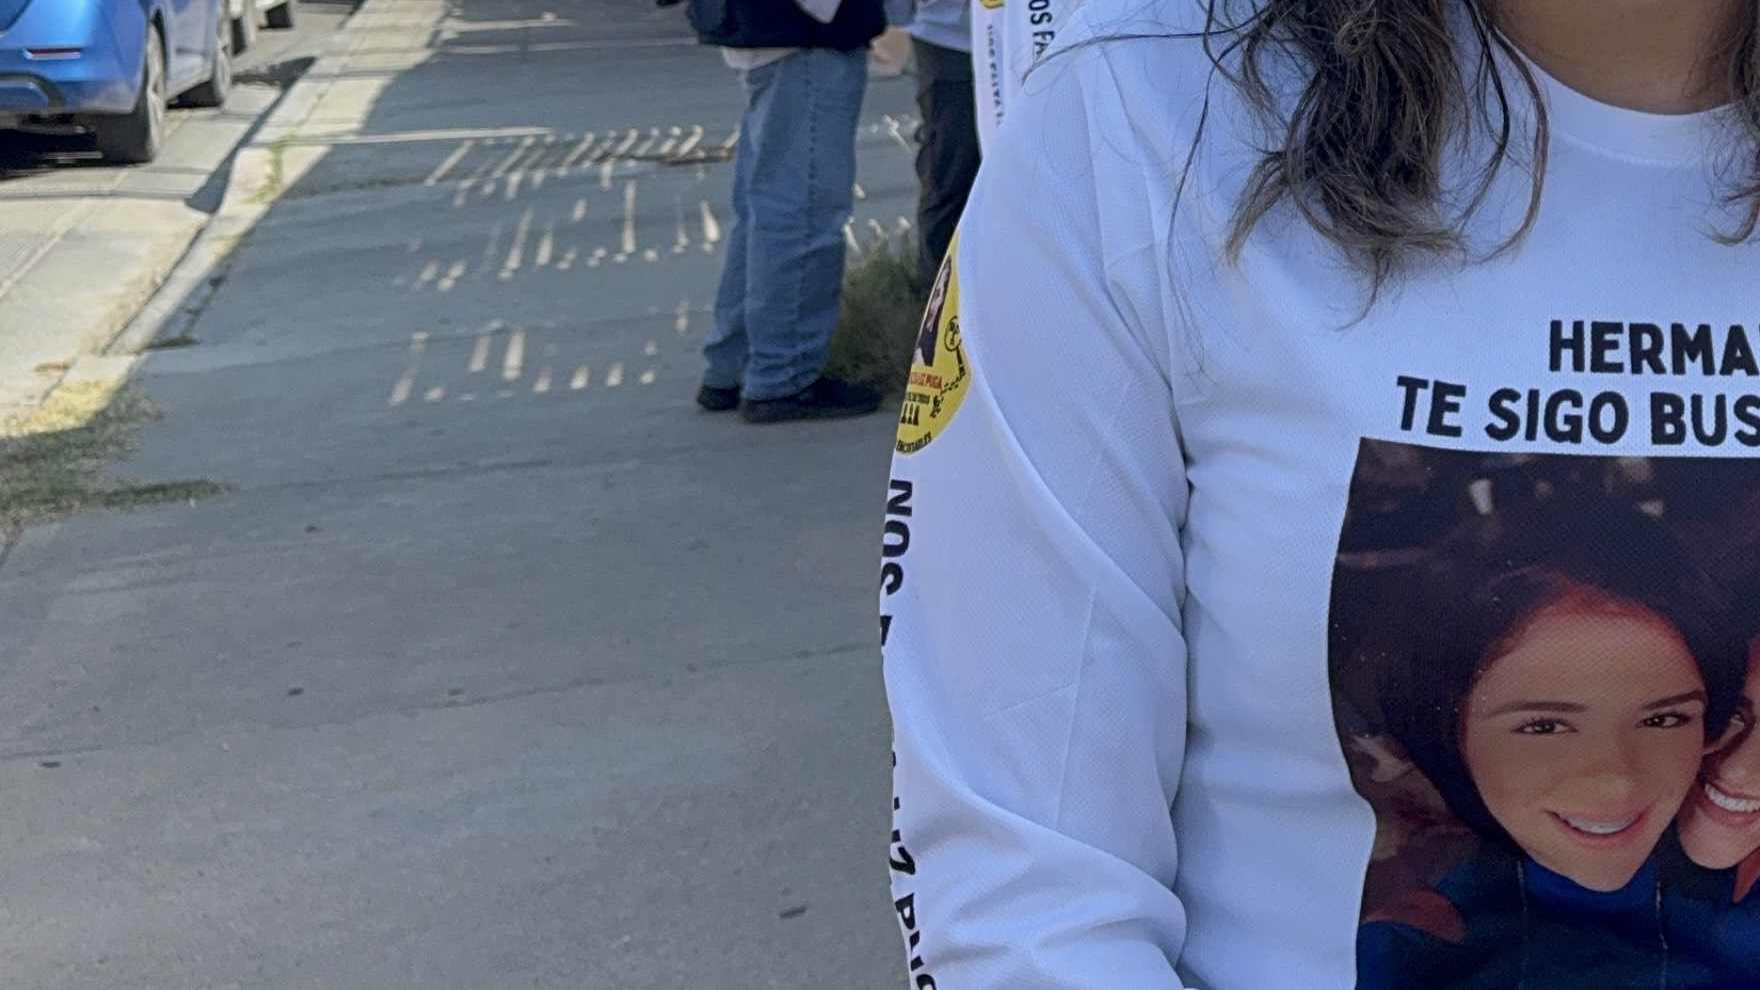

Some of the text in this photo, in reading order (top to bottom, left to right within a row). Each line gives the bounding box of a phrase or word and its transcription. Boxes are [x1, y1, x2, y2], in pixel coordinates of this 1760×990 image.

[1396, 376, 1466, 437] TE
[1484, 388, 1629, 444] SIGO
[880, 479, 913, 596] NOS
